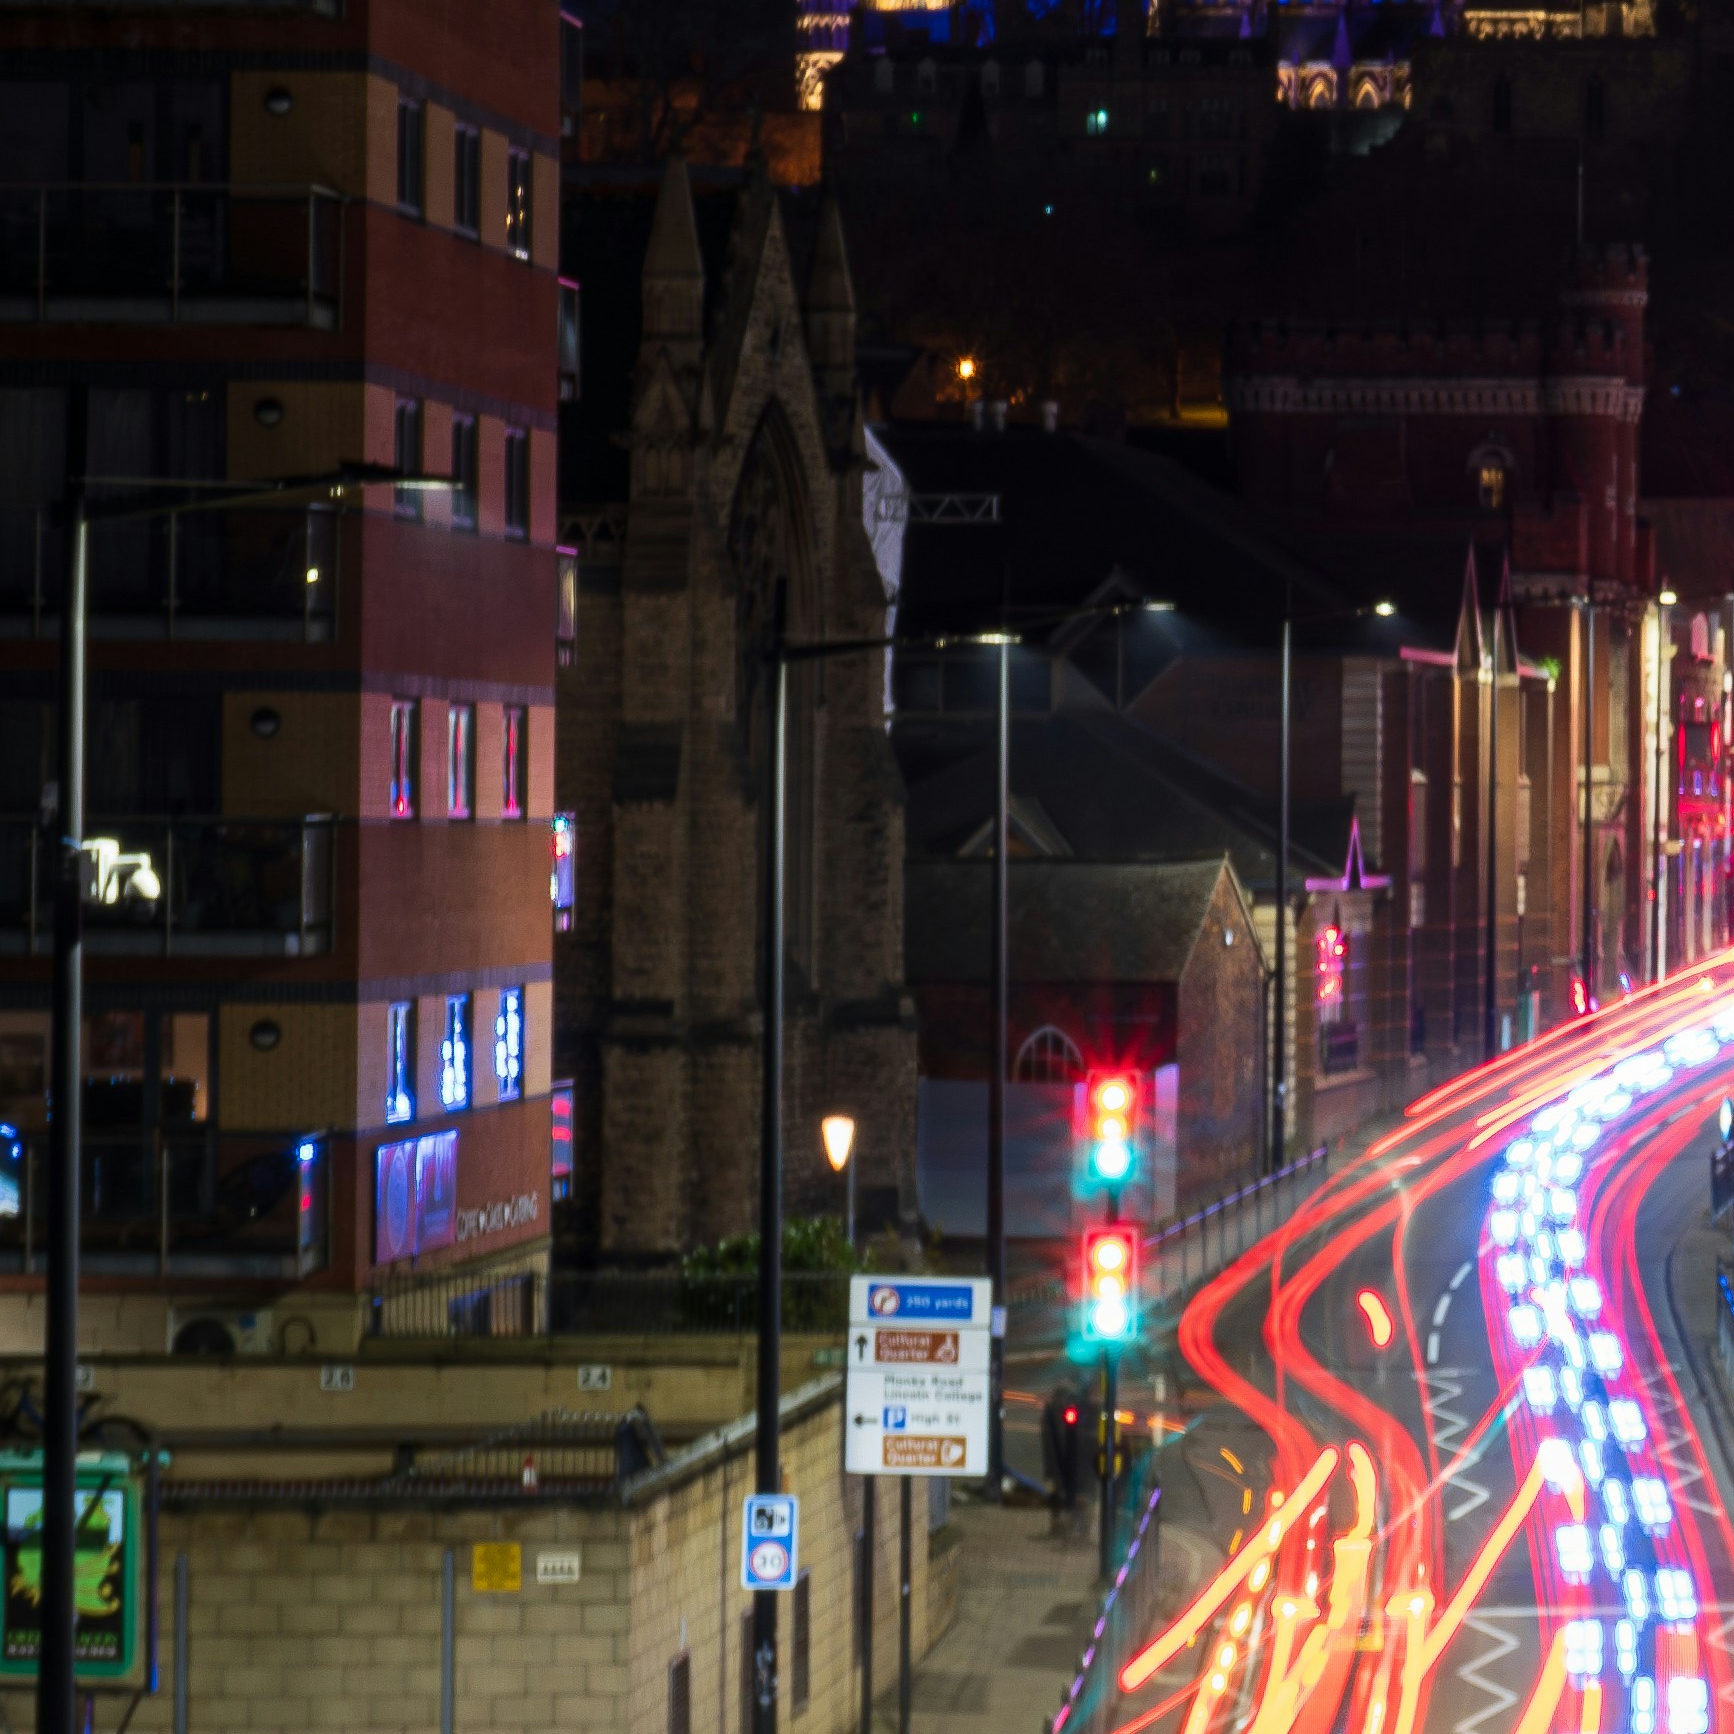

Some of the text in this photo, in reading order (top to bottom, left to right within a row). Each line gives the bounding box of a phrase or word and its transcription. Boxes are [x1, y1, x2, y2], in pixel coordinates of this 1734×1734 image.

[935, 1297, 969, 1311] yards
[879, 1333, 930, 1347] Cultural
[879, 1349, 929, 1363] Quarter
[931, 1375, 963, 1387] Road
[884, 1388, 982, 1404] Lincoln College
[886, 1437, 938, 1452] Cultural
[887, 1453, 938, 1466] Quarter
